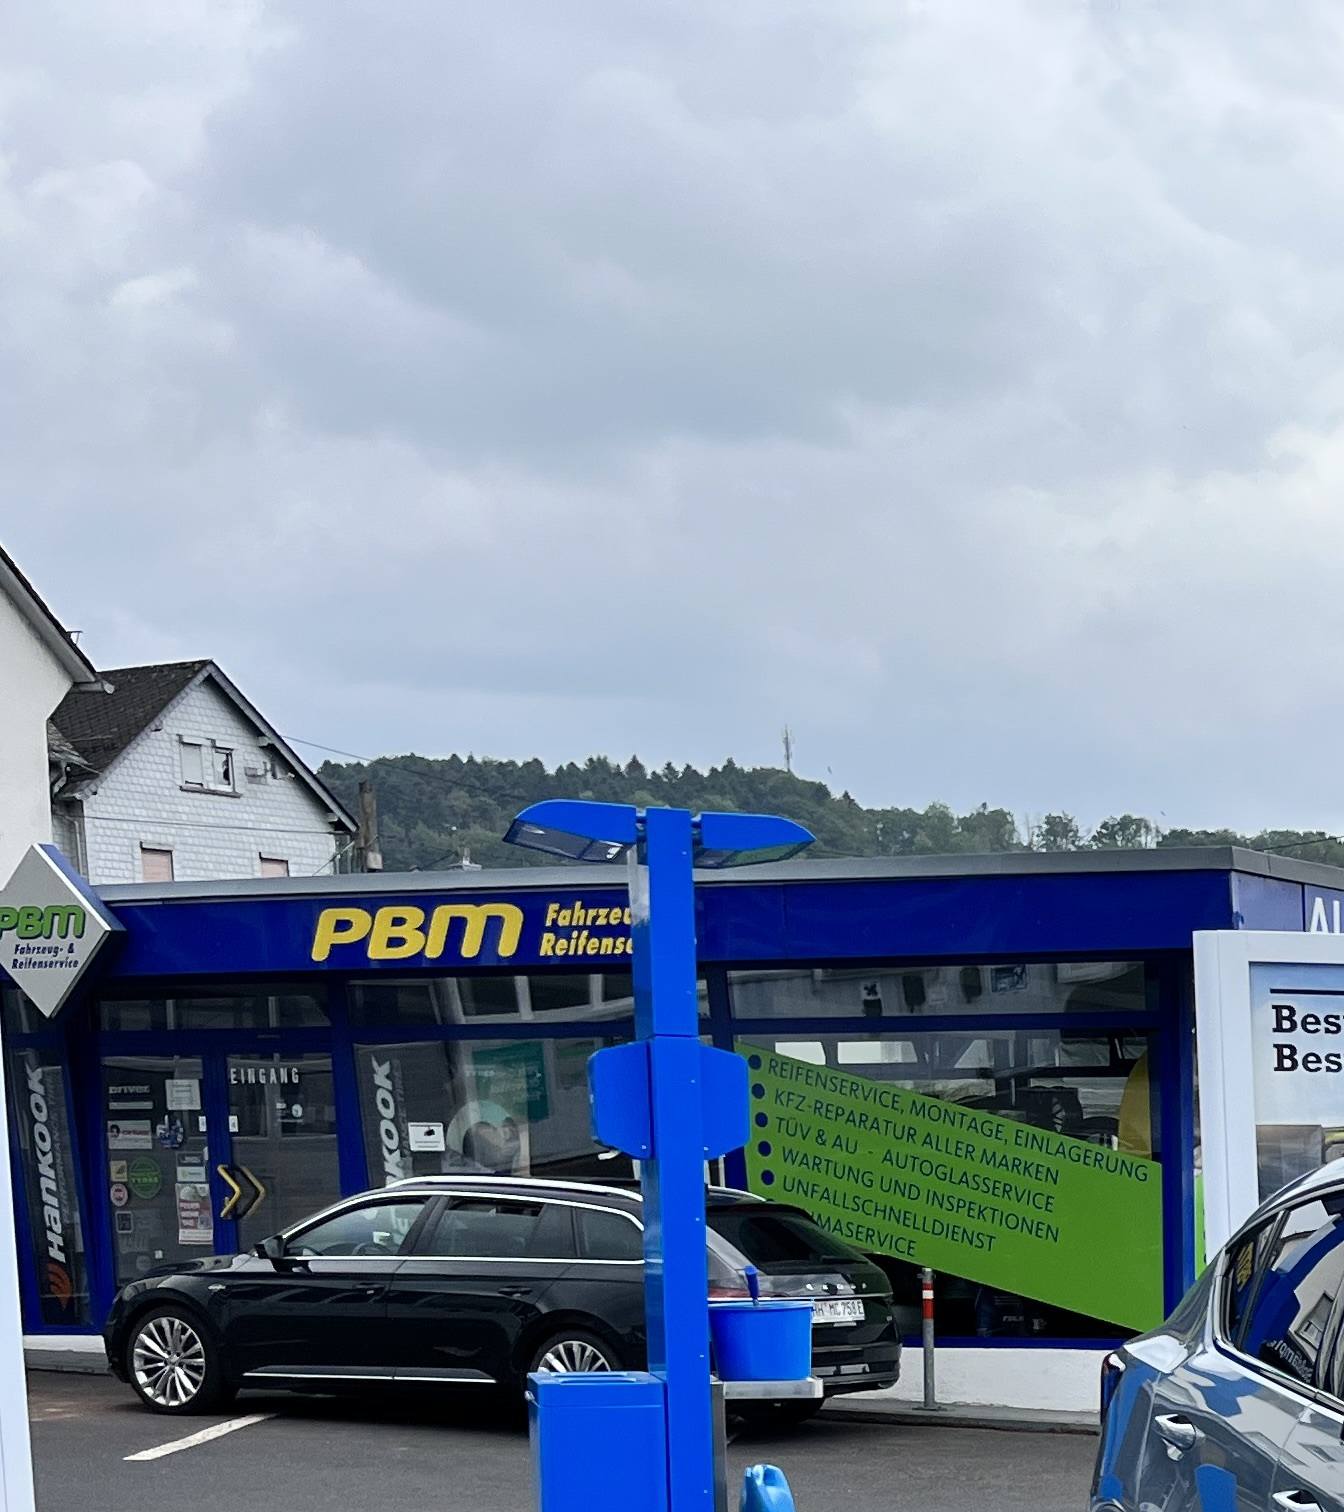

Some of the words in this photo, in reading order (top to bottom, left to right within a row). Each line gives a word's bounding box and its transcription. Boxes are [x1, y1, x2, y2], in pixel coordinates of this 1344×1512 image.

[311, 903, 523, 961] PBM
[545, 901, 632, 927] Fahrzeu
[12, 957, 79, 969] Reifenservice
[230, 1067, 300, 1085] EINGANG
[768, 1058, 904, 1114] REIFENSERVICE,
[910, 1100, 1008, 1145] MONTAGE,
[1014, 1129, 1148, 1182] EINLAGERUNG
[774, 1088, 916, 1144] KFZ-REPARATUR
[921, 1133, 975, 1162] ALLER
[980, 1148, 1060, 1185] MARKEN
[776, 1116, 811, 1141] TÜV
[815, 1129, 827, 1146] &
[832, 1134, 858, 1154] AU
[882, 1149, 1055, 1213] AUTOGLASSERVICE
[782, 1146, 874, 1188] WARTUNG
[880, 1175, 920, 1201] UND
[926, 1189, 1060, 1243] INSPEKTIONEN
[784, 1175, 997, 1252] UNFALLSCHNELLDIENST
[811, 1211, 916, 1256] MASERVICE
